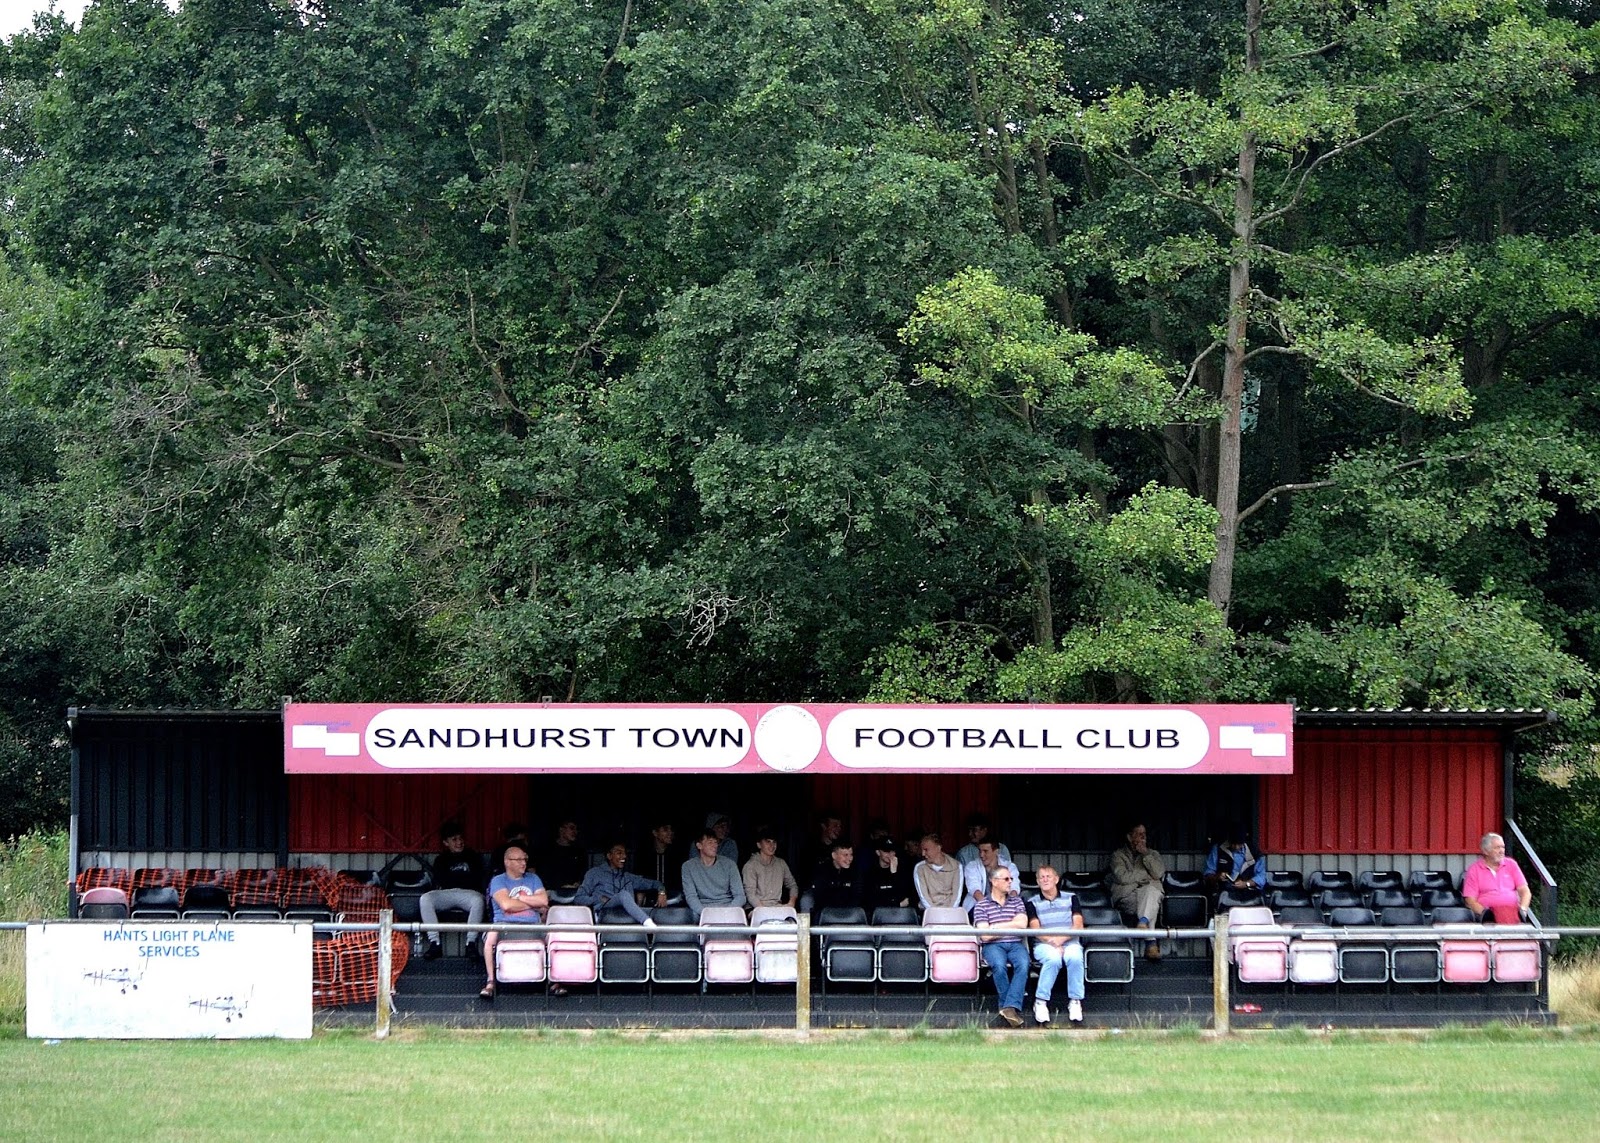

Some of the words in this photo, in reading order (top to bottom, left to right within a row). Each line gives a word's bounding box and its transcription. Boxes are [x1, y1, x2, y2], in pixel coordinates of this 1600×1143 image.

[374, 728, 616, 748] SANDHURST
[628, 728, 743, 748] TOWN
[855, 728, 1062, 749] FOOTBALL
[1076, 728, 1180, 749] CLUB
[104, 930, 148, 942] HANTS
[153, 930, 188, 942] LIGHT
[193, 930, 235, 942] PLANE
[138, 946, 200, 957] SERVICES
